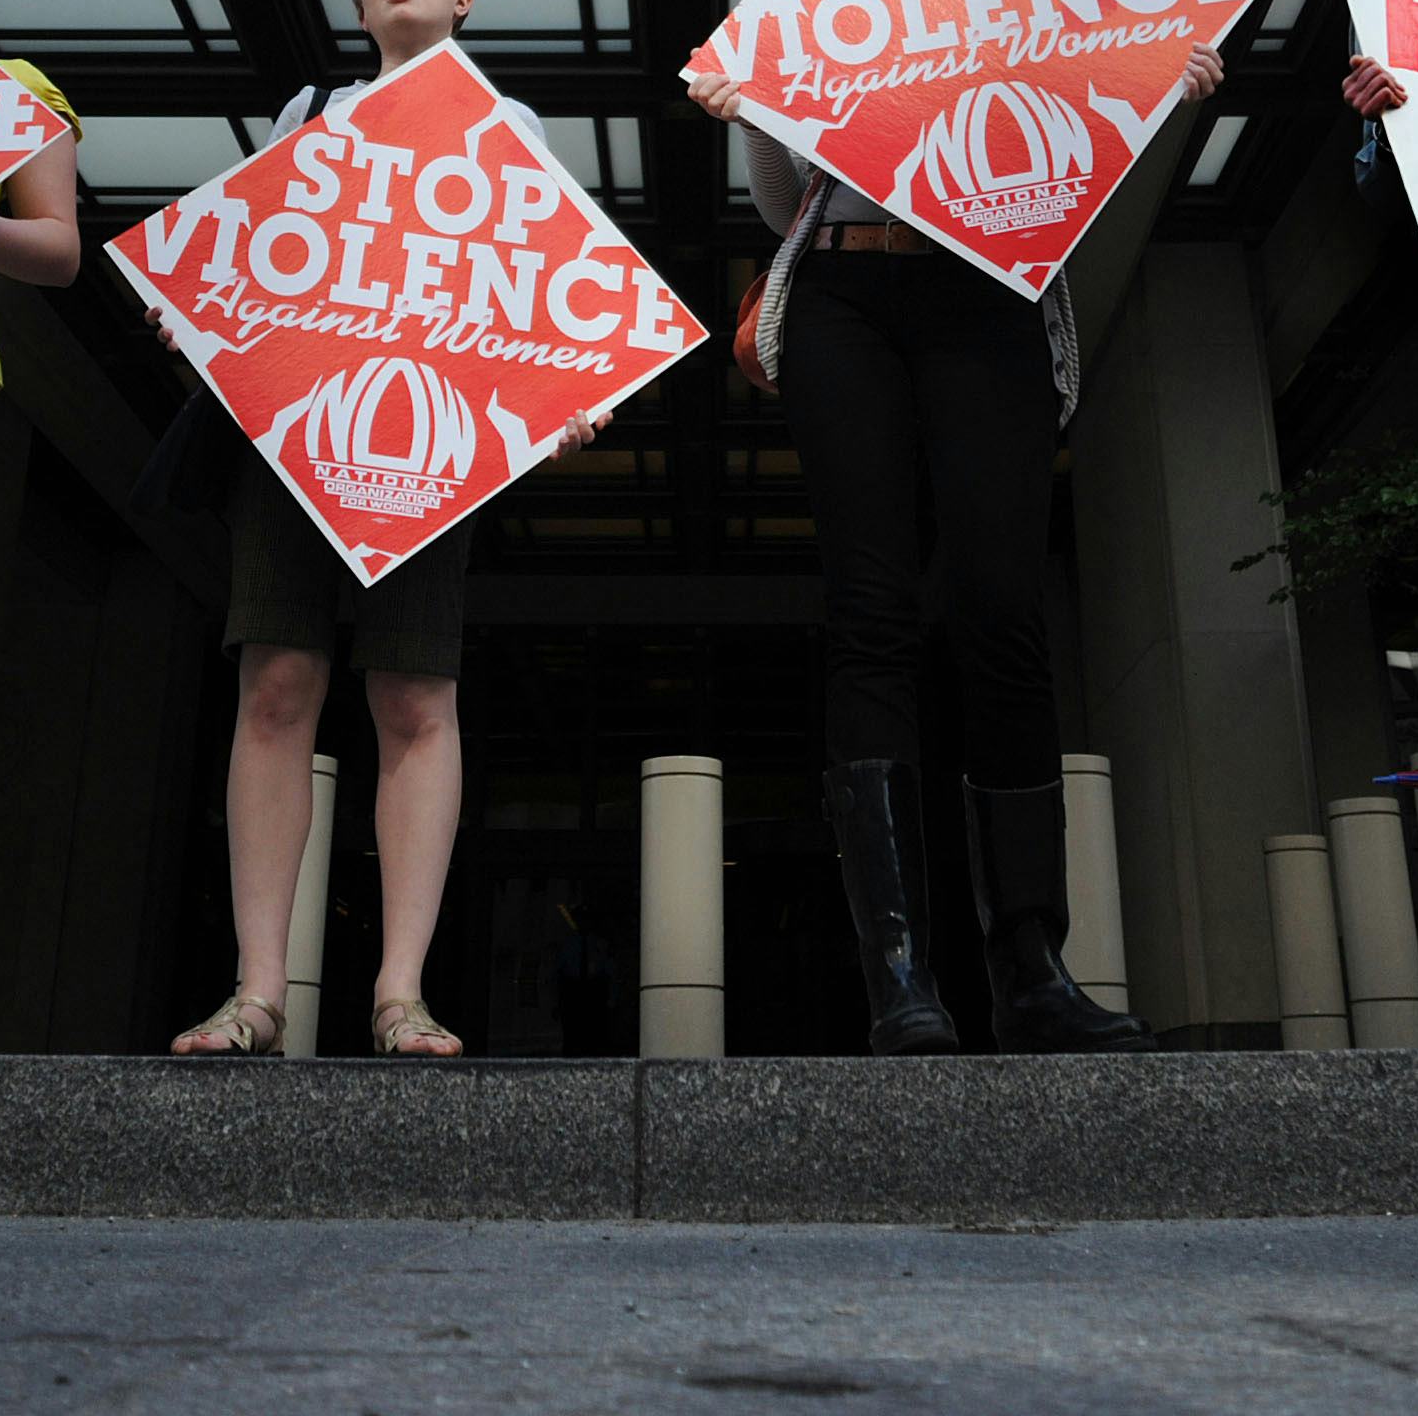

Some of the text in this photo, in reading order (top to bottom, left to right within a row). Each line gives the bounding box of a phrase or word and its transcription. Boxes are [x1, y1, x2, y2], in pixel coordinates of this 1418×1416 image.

[782, 16, 1193, 116] Against Women
[284, 132, 561, 243] STOP
[924, 81, 1094, 201] NOW
[948, 181, 1087, 215] NATIONAL
[144, 194, 685, 353] VIOLENCE
[193, 276, 614, 375] Against Women
[305, 357, 476, 479] NOW
[315, 465, 455, 495] NATIONAL
